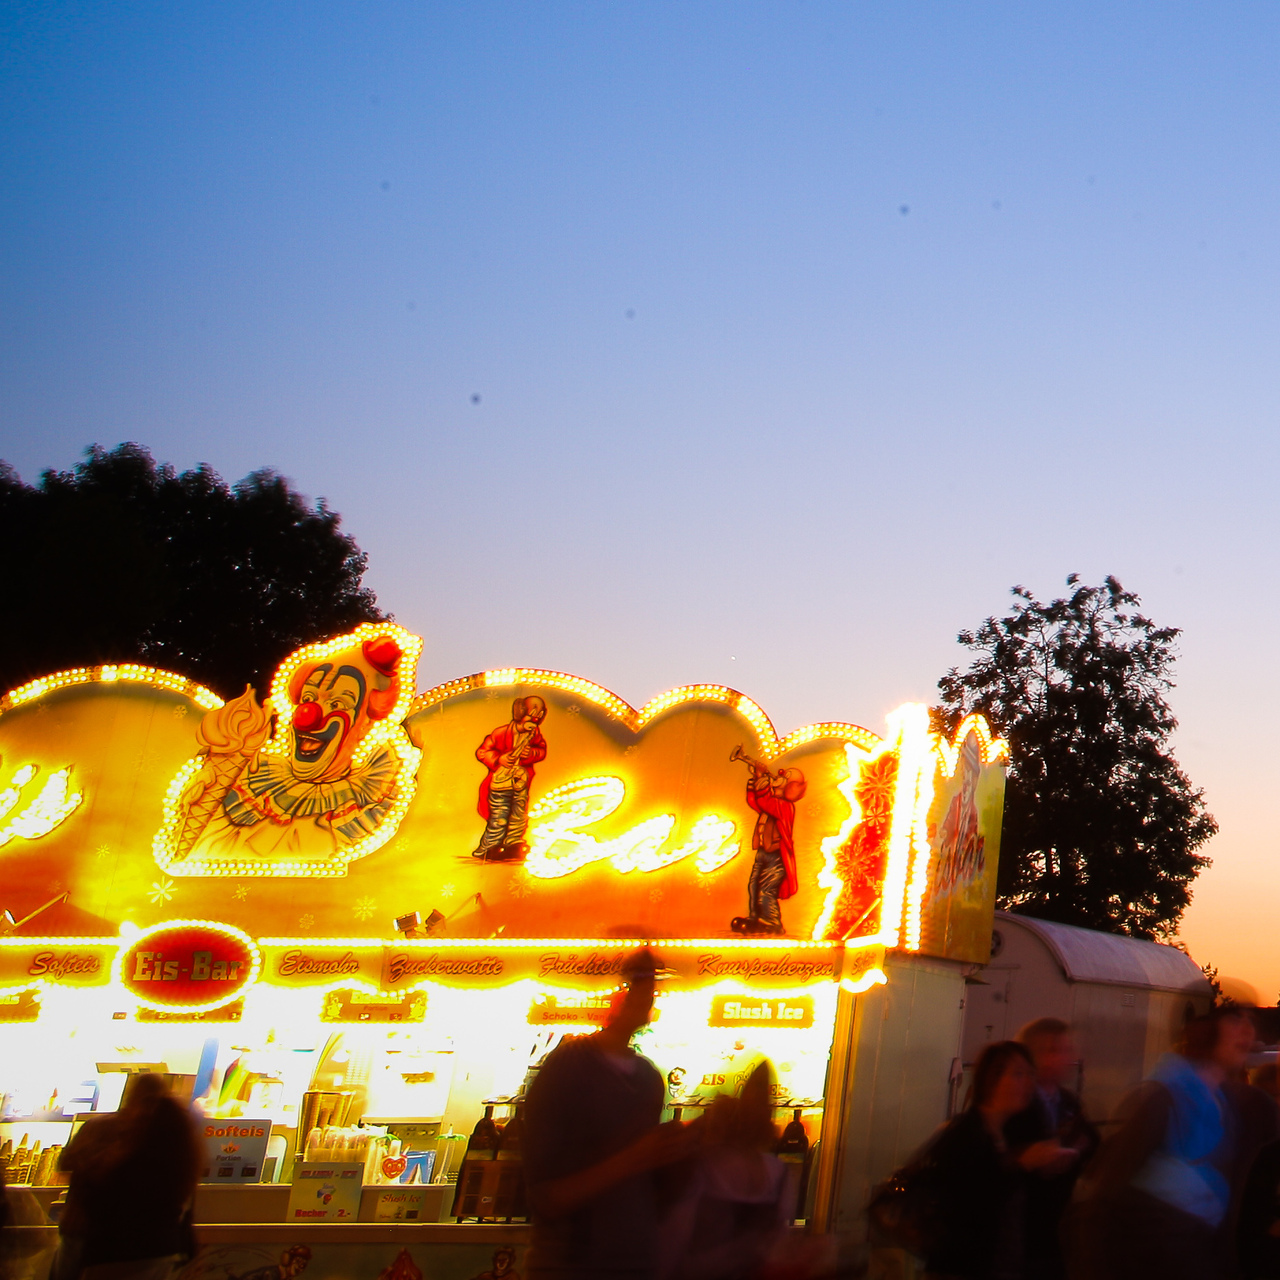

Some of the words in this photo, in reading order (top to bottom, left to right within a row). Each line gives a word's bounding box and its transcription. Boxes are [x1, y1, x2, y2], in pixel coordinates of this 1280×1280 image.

[525, 775, 741, 879] Bar
[28, 950, 100, 980] Softeis
[132, 951, 244, 981] Eis-Bar
[279, 949, 359, 976] Eismohr
[388, 951, 504, 983] Zuckerwatte
[538, 952, 625, 977] Früchteb
[697, 953, 834, 983] Knusperherzen
[542, 1012, 578, 1020] Schoko
[722, 1002, 772, 1020] Slush
[776, 1002, 804, 1020] Ice
[701, 1073, 727, 1086] EIS
[204, 1125, 265, 1138] Softeis
[382, 1193, 406, 1203] Slush
[409, 1194, 422, 1203] Ice
